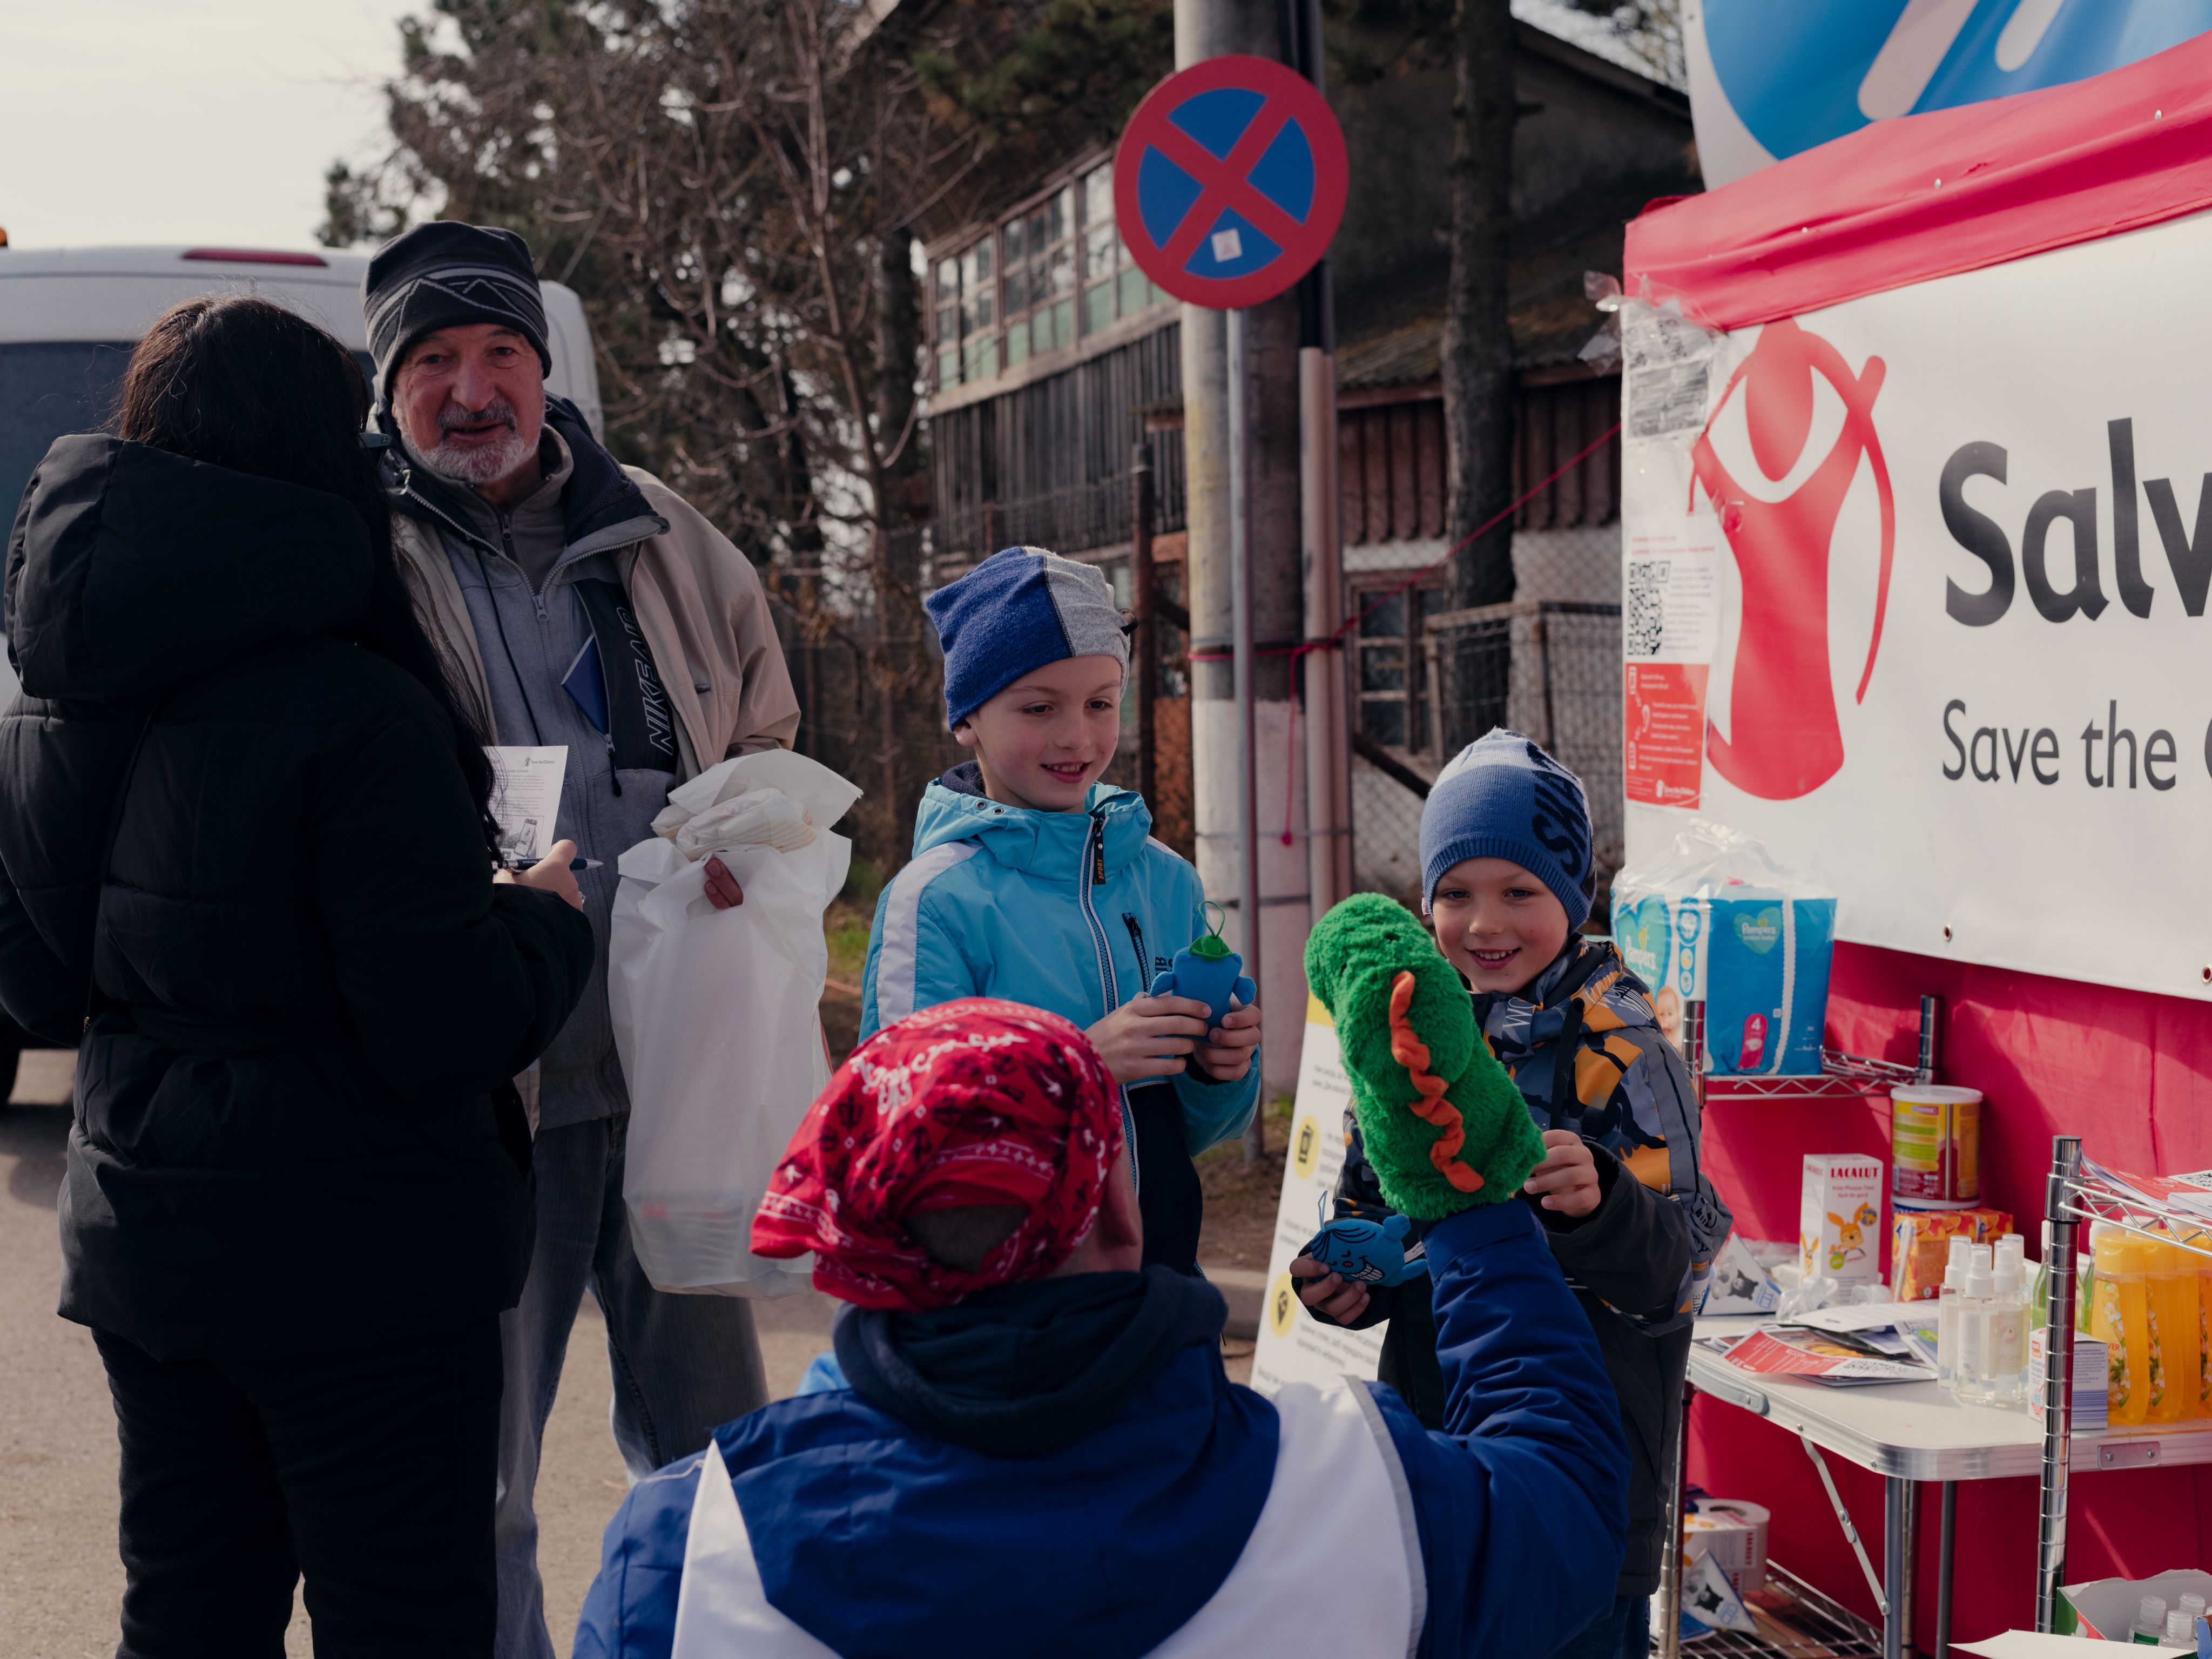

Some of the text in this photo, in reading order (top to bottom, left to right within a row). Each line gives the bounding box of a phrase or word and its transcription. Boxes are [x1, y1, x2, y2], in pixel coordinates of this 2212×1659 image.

[635, 659, 673, 756] NIKE
[1943, 699, 2059, 785] Save
[2080, 699, 2177, 791] the
[1742, 922, 1777, 935] Pampers
[1625, 934, 1657, 970] Pampers
[1751, 1017, 1762, 1031] 4
[1831, 1167, 1878, 1178] LACALUT
